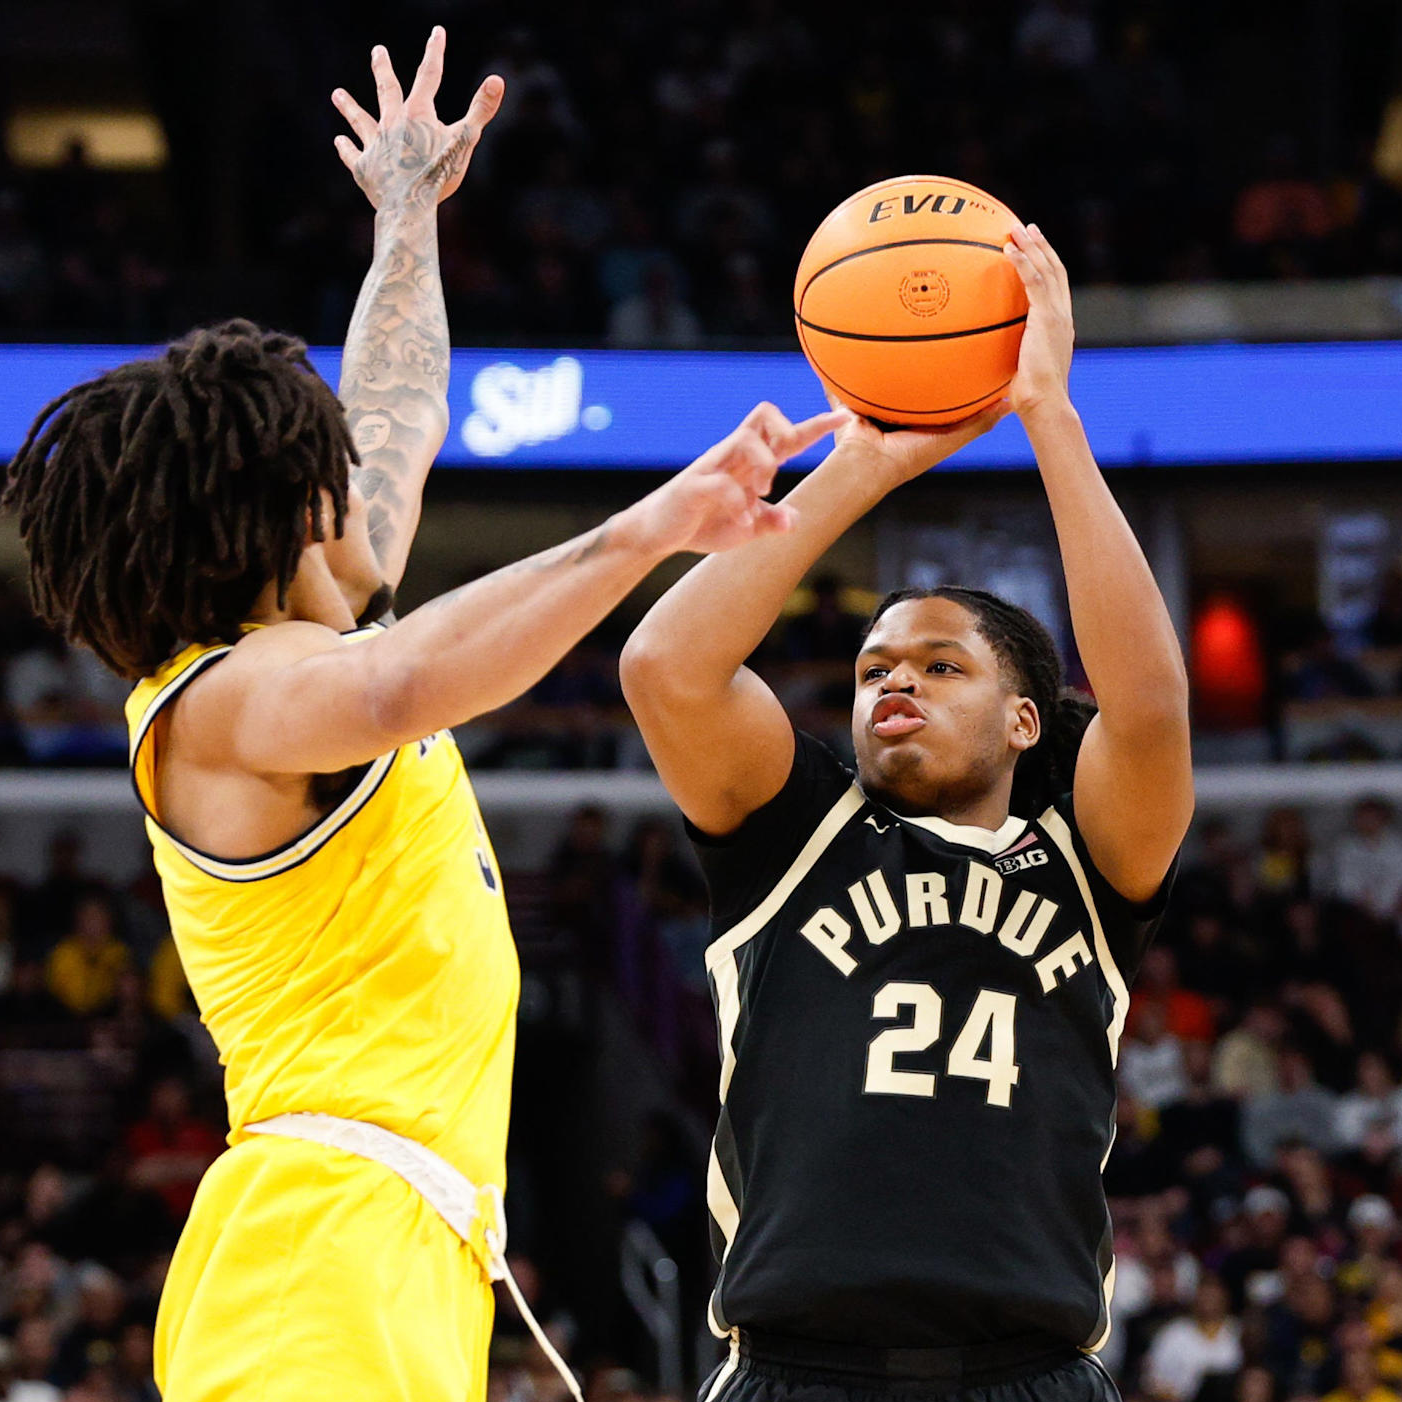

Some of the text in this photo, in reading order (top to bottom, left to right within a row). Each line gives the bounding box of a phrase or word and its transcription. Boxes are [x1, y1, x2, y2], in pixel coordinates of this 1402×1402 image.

[868, 193, 966, 224] EVO
[801, 860, 1093, 995] PURDUE
[861, 980, 1022, 1109] 24
